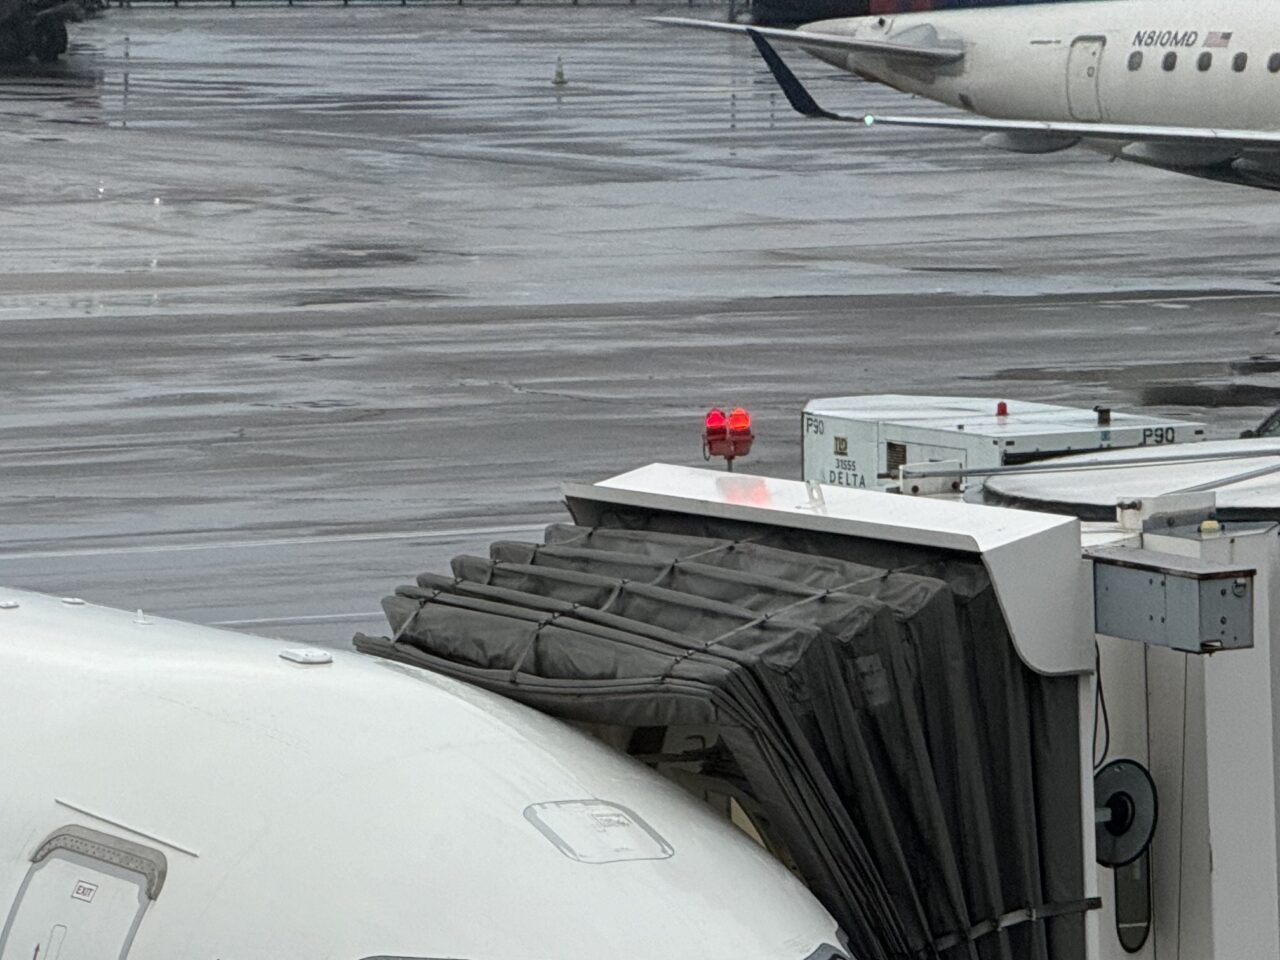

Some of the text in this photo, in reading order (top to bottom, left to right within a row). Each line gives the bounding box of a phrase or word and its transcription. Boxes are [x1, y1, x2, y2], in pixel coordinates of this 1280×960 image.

[1132, 30, 1199, 47] N810MD
[806, 417, 825, 435] P90
[1142, 426, 1175, 444] P90
[829, 470, 866, 488] DELTA
